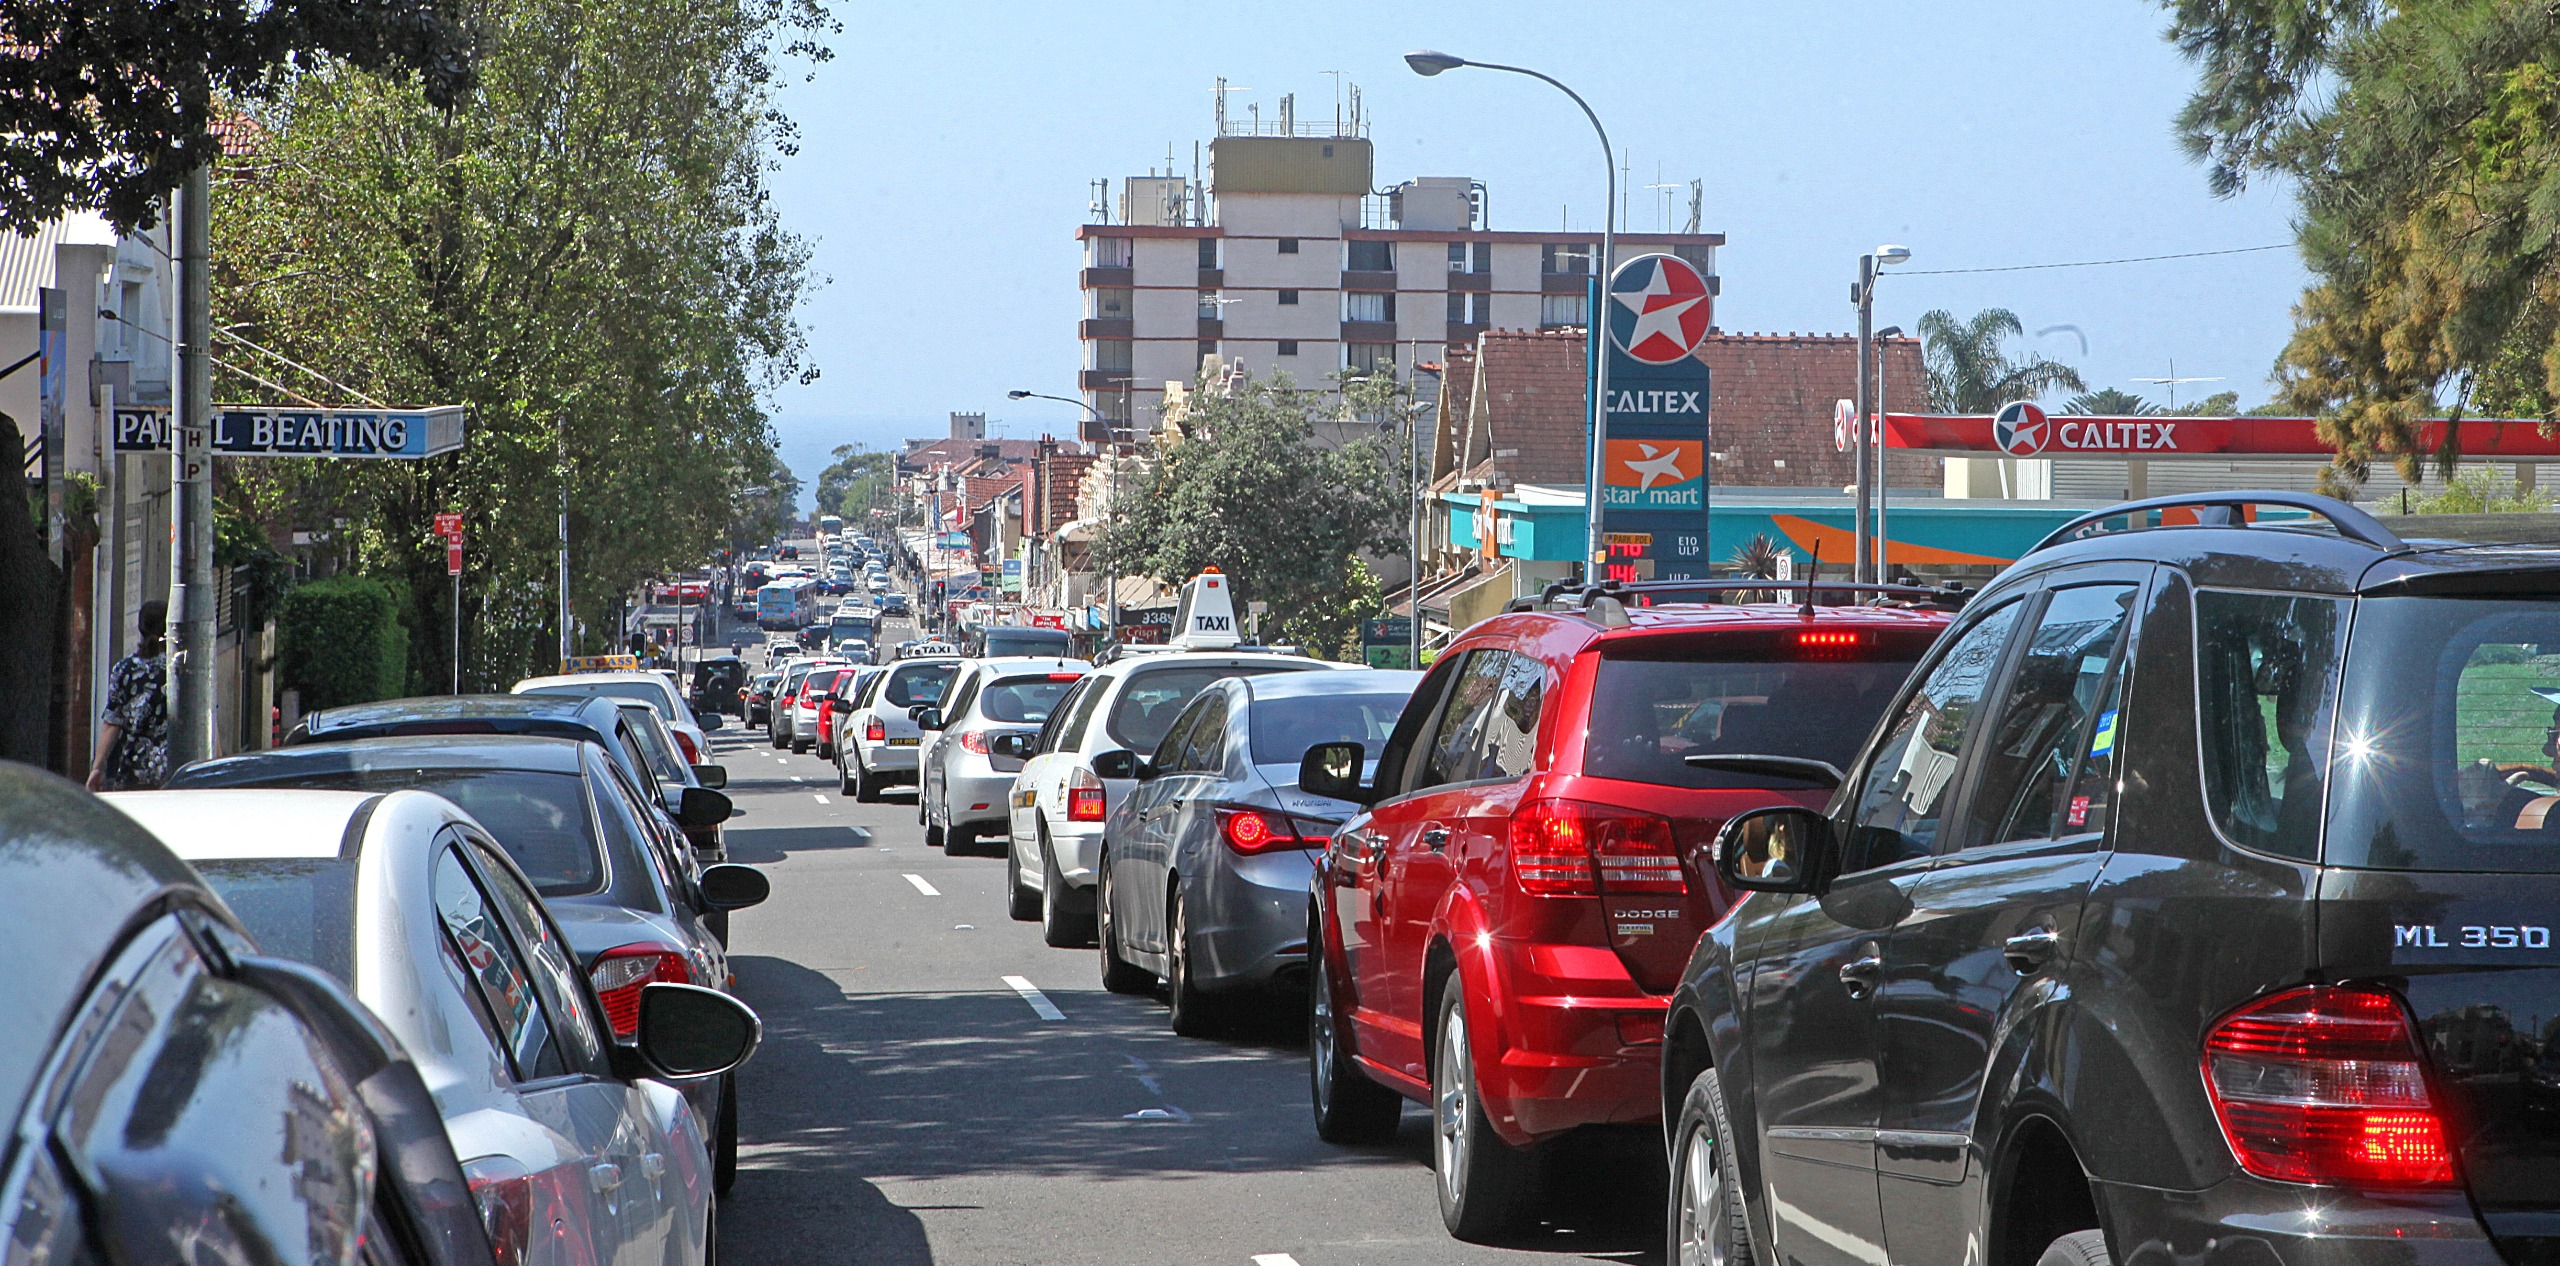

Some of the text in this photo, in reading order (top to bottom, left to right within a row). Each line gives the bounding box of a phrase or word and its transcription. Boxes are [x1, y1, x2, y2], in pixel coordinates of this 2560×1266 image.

[1606, 391, 1700, 413] CALTEX
[118, 413, 408, 449] PAL BEATING
[188, 427, 200, 448] H
[2060, 422, 2177, 448] CALTEX
[188, 463, 199, 479] P
[1603, 487, 1698, 505] star mart
[1613, 534, 1648, 544] PARK PDE
[1678, 536, 1697, 546] E10
[1678, 546, 1699, 556] ULP
[1196, 616, 1229, 631] TAXI
[1126, 626, 1159, 639] Crispy
[922, 646, 951, 654] TAXI
[1614, 910, 1679, 918] DODGE
[2394, 925, 2550, 948] ML 350
